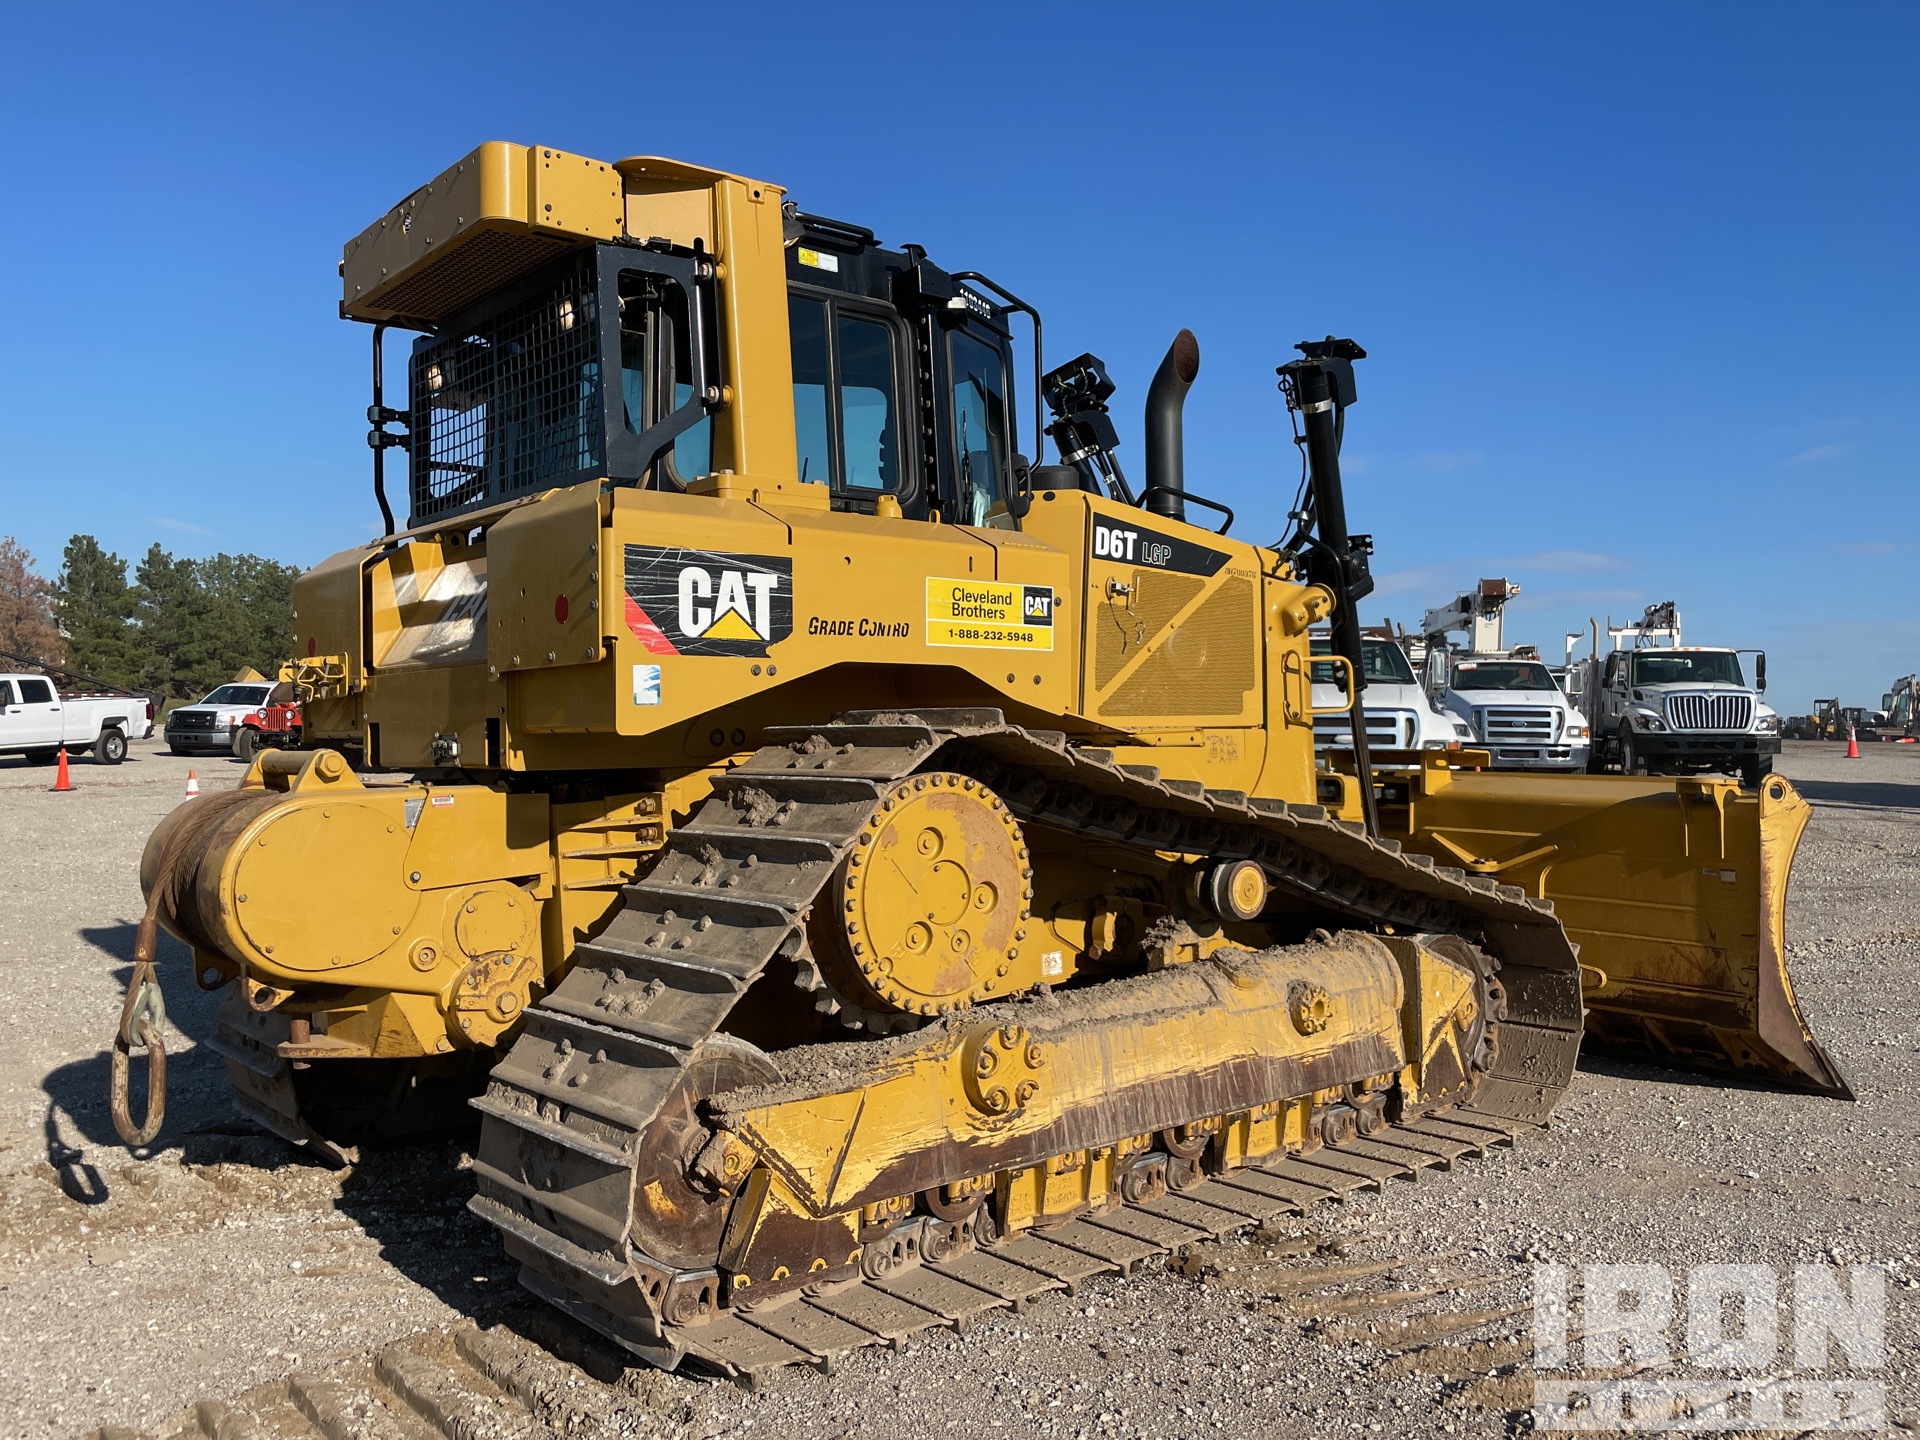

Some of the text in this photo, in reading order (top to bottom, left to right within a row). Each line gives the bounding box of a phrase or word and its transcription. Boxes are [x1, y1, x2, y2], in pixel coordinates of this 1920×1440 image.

[1095, 526, 1172, 566] D6T LGP
[678, 566, 778, 641] CAT
[951, 587, 1012, 606] Cleveland
[1024, 595, 1052, 617] CAT
[951, 602, 1006, 620] Brothers
[808, 616, 855, 637] GRADE
[948, 628, 1034, 643] 1-888-232-5948
